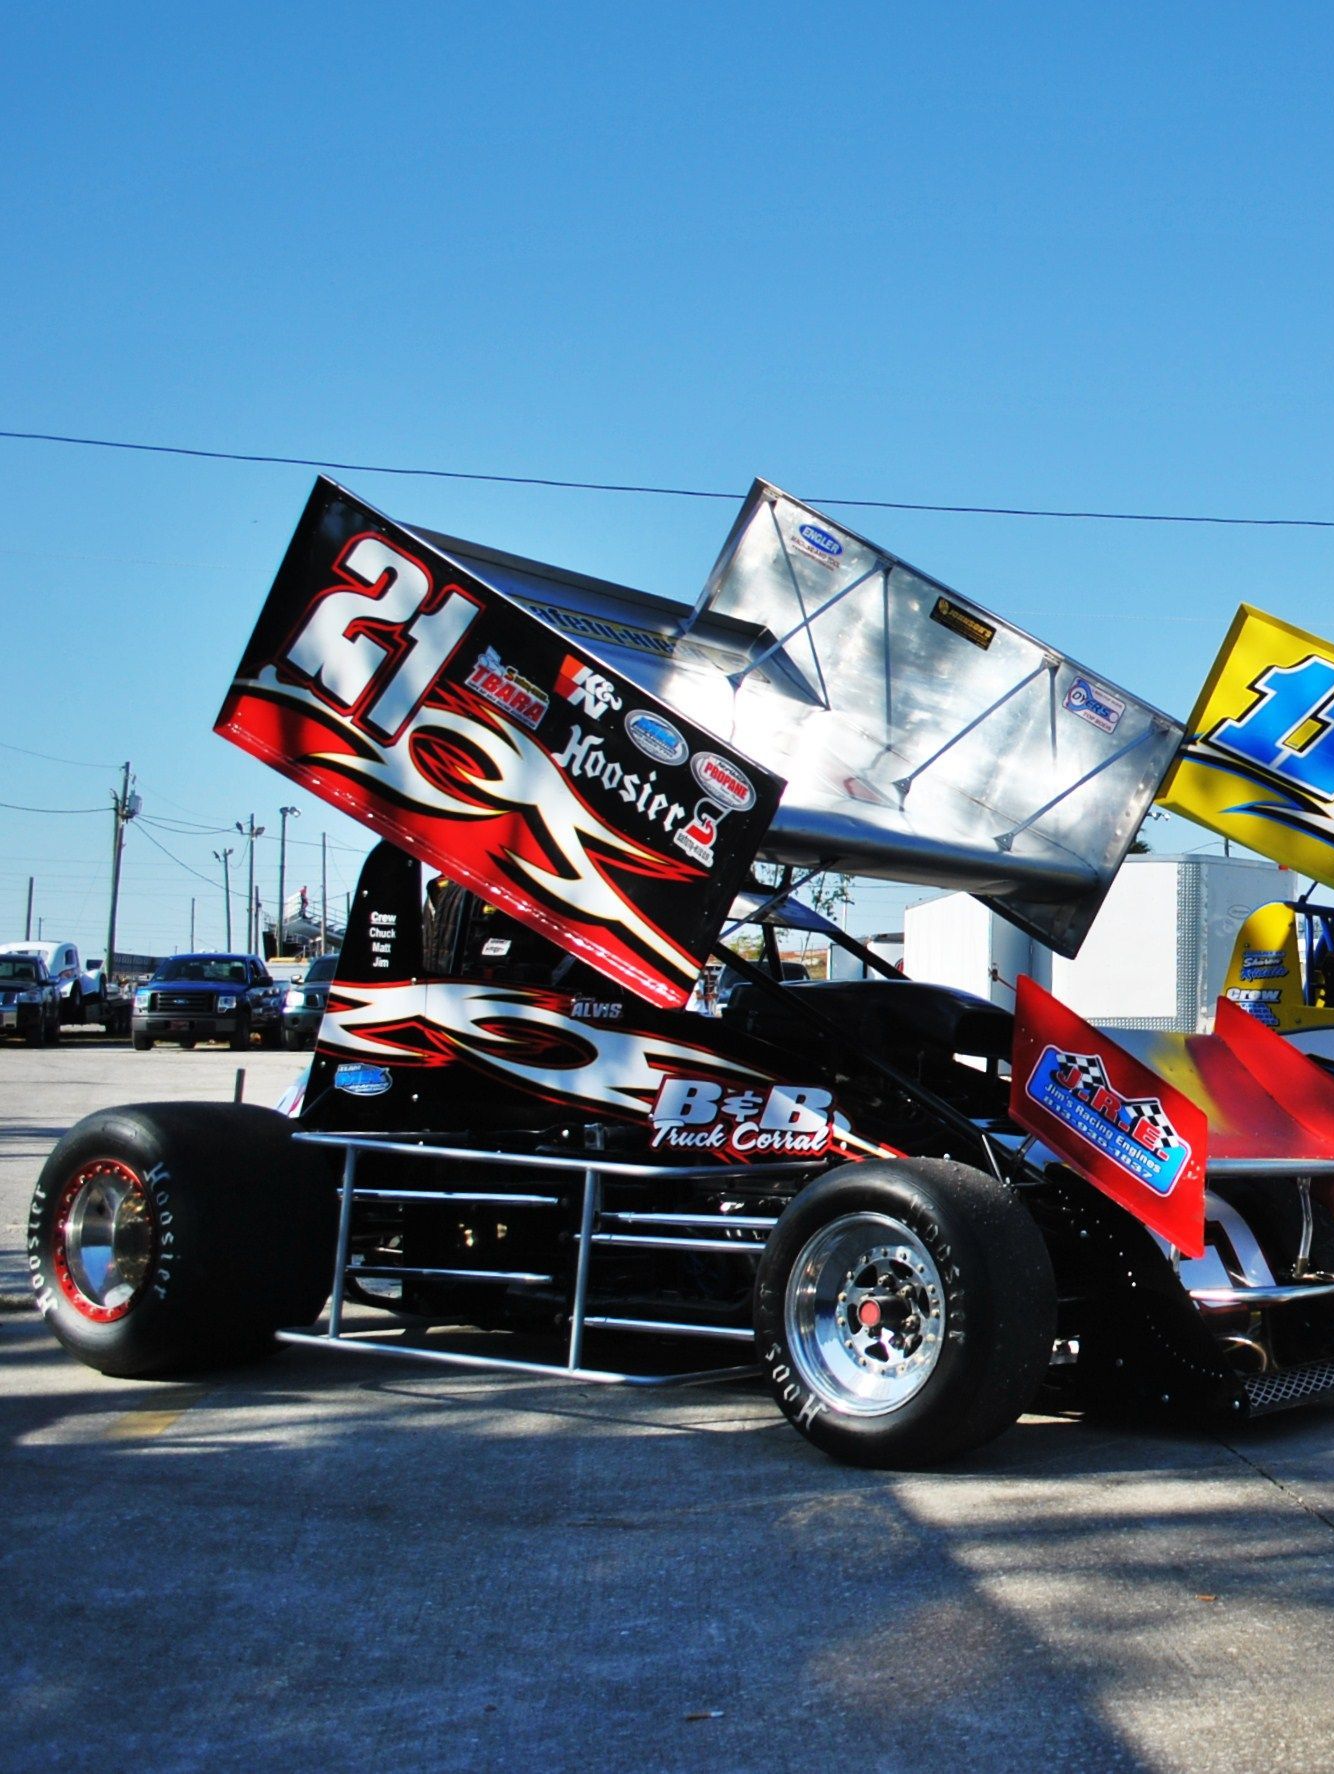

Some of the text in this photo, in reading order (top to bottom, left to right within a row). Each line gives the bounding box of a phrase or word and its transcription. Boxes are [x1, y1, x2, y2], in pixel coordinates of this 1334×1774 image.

[286, 533, 485, 746] 21
[471, 664, 545, 722] TBARA
[551, 724, 686, 833] Hoosier
[703, 761, 749, 800] PROPANE
[369, 927, 396, 938] Chuck
[371, 911, 396, 924] Crew
[372, 942, 391, 953] Matt
[372, 956, 389, 968] Jim
[653, 1079, 833, 1133] B&B
[1045, 1084, 1161, 1173] Jim's Racing Engines
[652, 1119, 829, 1151] Truck Corral
[27, 1185, 59, 1317] Hoosier
[143, 1162, 174, 1299] Hoosier
